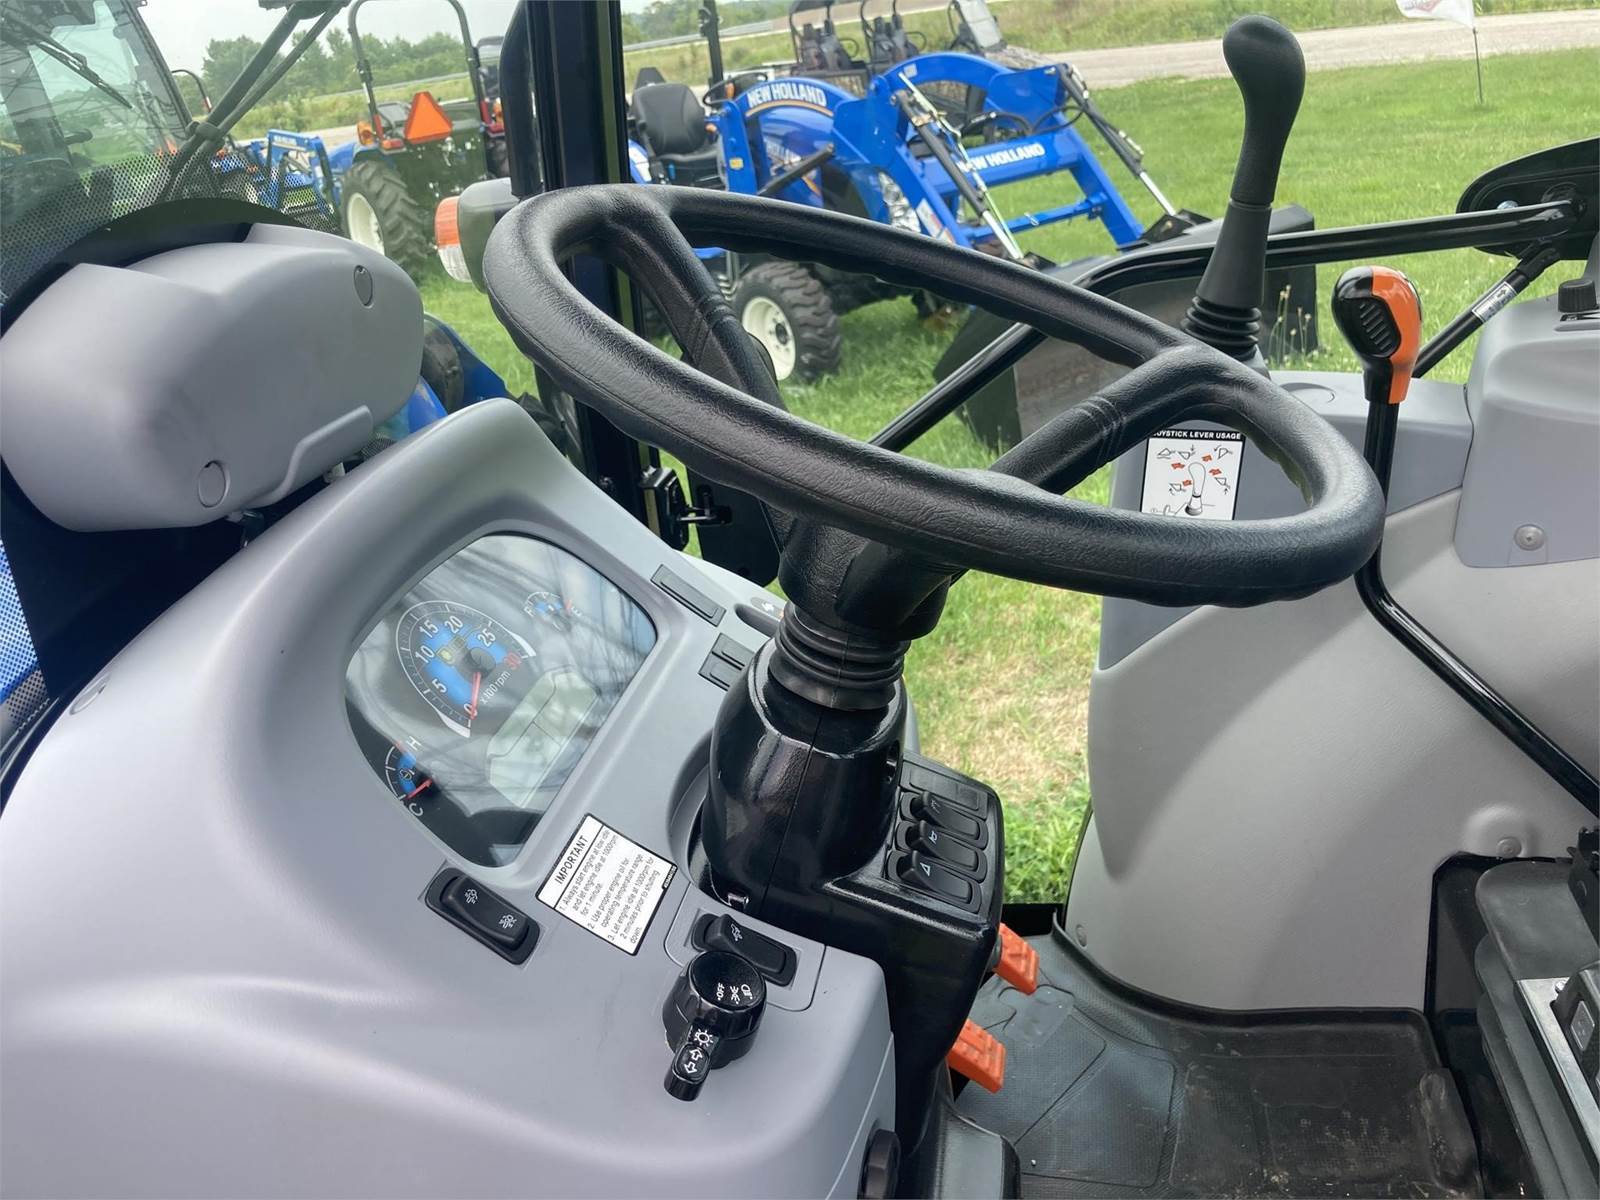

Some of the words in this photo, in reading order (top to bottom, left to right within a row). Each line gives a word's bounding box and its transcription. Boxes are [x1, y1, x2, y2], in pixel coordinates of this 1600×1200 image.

[747, 85, 772, 108] NEW
[770, 82, 827, 107] HOLLAND
[985, 143, 1046, 167] HOLLAND
[1190, 431, 1215, 439] LEVER
[1216, 432, 1241, 440] USAGE
[419, 619, 439, 638] 15
[444, 615, 464, 634] 20
[477, 628, 496, 647] 25
[415, 645, 435, 663] 10
[432, 678, 447, 693] 5
[463, 703, 478, 718] 0
[406, 735, 422, 751] H
[408, 802, 424, 817] C
[553, 835, 589, 884] IMPORTANT
[617, 864, 626, 873] oil
[621, 856, 629, 866] for
[562, 883, 579, 906] Always
[574, 871, 585, 885] start
[581, 853, 597, 874] engine
[571, 898, 582, 911] and
[577, 889, 587, 899] let
[582, 872, 599, 893] engine
[593, 861, 603, 873] idle
[608, 872, 623, 893] engine
[597, 890, 613, 911] proper
[600, 899, 620, 929] operating
[614, 868, 636, 901] temperature
[631, 853, 644, 870] range
[611, 922, 620, 934] Let
[616, 903, 632, 925] engine
[626, 892, 636, 904] idle
[646, 856, 654, 865] for
[580, 905, 589, 916] for
[622, 910, 638, 934] minutes
[634, 896, 646, 912] prior
[644, 869, 660, 892] shutting
[590, 909, 602, 922] Use
[716, 982, 725, 998] OFF
